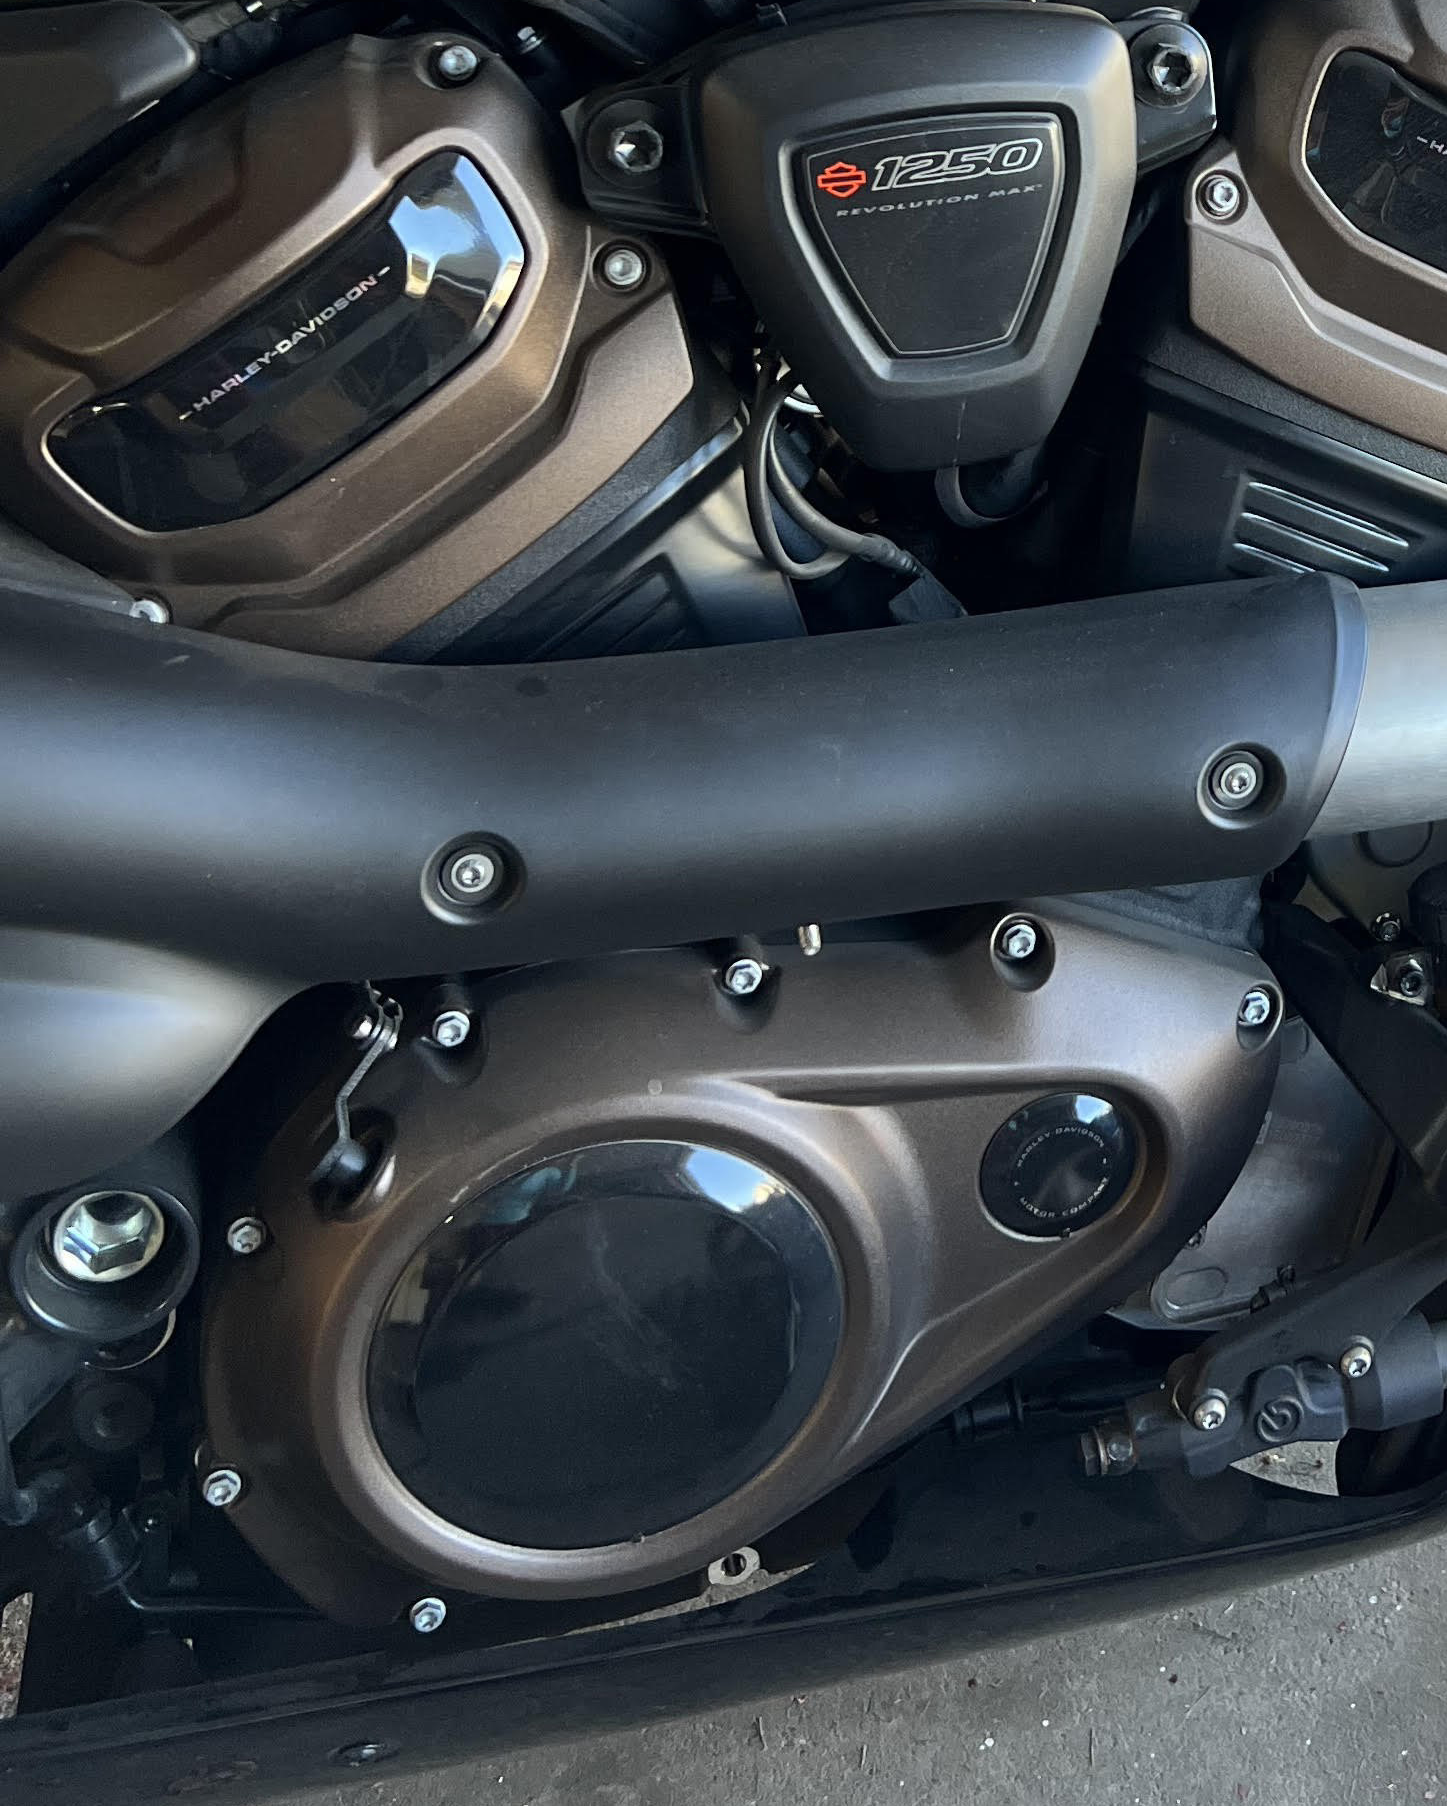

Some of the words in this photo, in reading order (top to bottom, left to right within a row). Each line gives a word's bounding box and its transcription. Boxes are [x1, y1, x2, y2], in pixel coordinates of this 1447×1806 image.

[871, 138, 1043, 191] 1250
[836, 193, 979, 218] REVOLUTION
[193, 274, 378, 412] HARLEY-DAVIDSON
